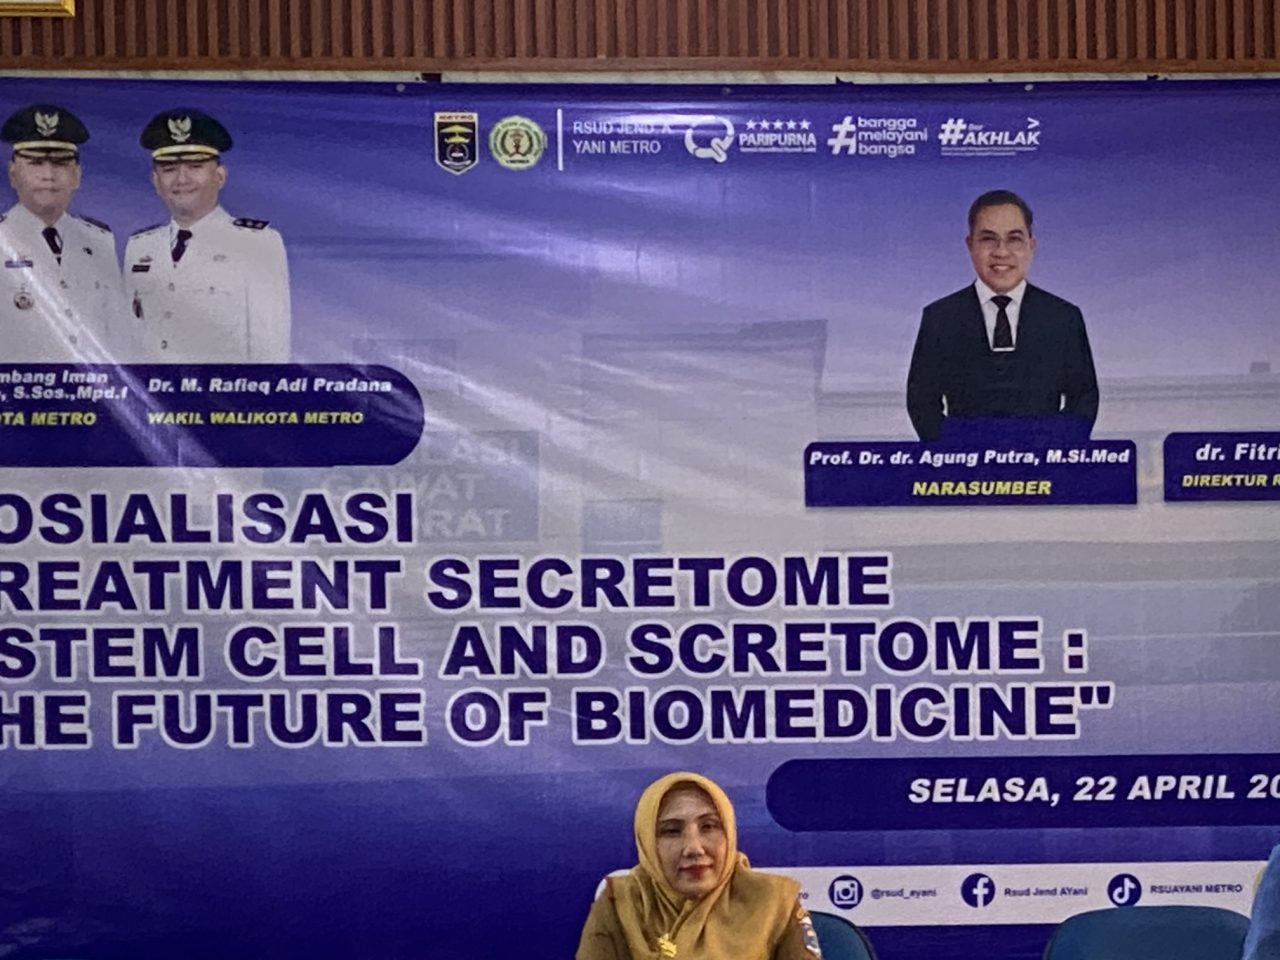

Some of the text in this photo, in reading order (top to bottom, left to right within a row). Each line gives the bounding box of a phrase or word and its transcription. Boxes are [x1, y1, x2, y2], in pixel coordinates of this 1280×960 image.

[858, 116, 917, 130] bangga
[739, 132, 817, 146] PARIPURNA
[858, 128, 928, 143] melayani
[573, 140, 661, 154] YANI METRO
[858, 142, 915, 158] bangsa
[62, 369, 108, 383] Iman
[148, 377, 392, 395] Dr. M. Rafieq Adi Pradana
[31, 412, 97, 426] METRO
[148, 412, 364, 425] WAKIL WALIKOTA METRO
[809, 448, 1130, 468] Prof. Dr. dr. Agung Putra, M.Si.Med
[1195, 443, 1225, 461] dr.
[912, 480, 1052, 496] NARASUMBER
[1182, 473, 1267, 488] DIREKTUR
[0, 492, 413, 546] OSIALISASI
[0, 555, 891, 611] REATMENT SECRETOME
[0, 620, 1084, 679] STEM CELL AND SCRETOME :
[115, 692, 424, 745] FUTURE
[449, 691, 549, 742] OF
[575, 685, 1112, 741] BIOMEDICINE"
[908, 776, 1061, 807] SELASA,
[1073, 776, 1118, 801] 22
[1127, 775, 1236, 800] APRIL
[1032, 887, 1057, 896] Jend
[1205, 883, 1243, 893] METRO
